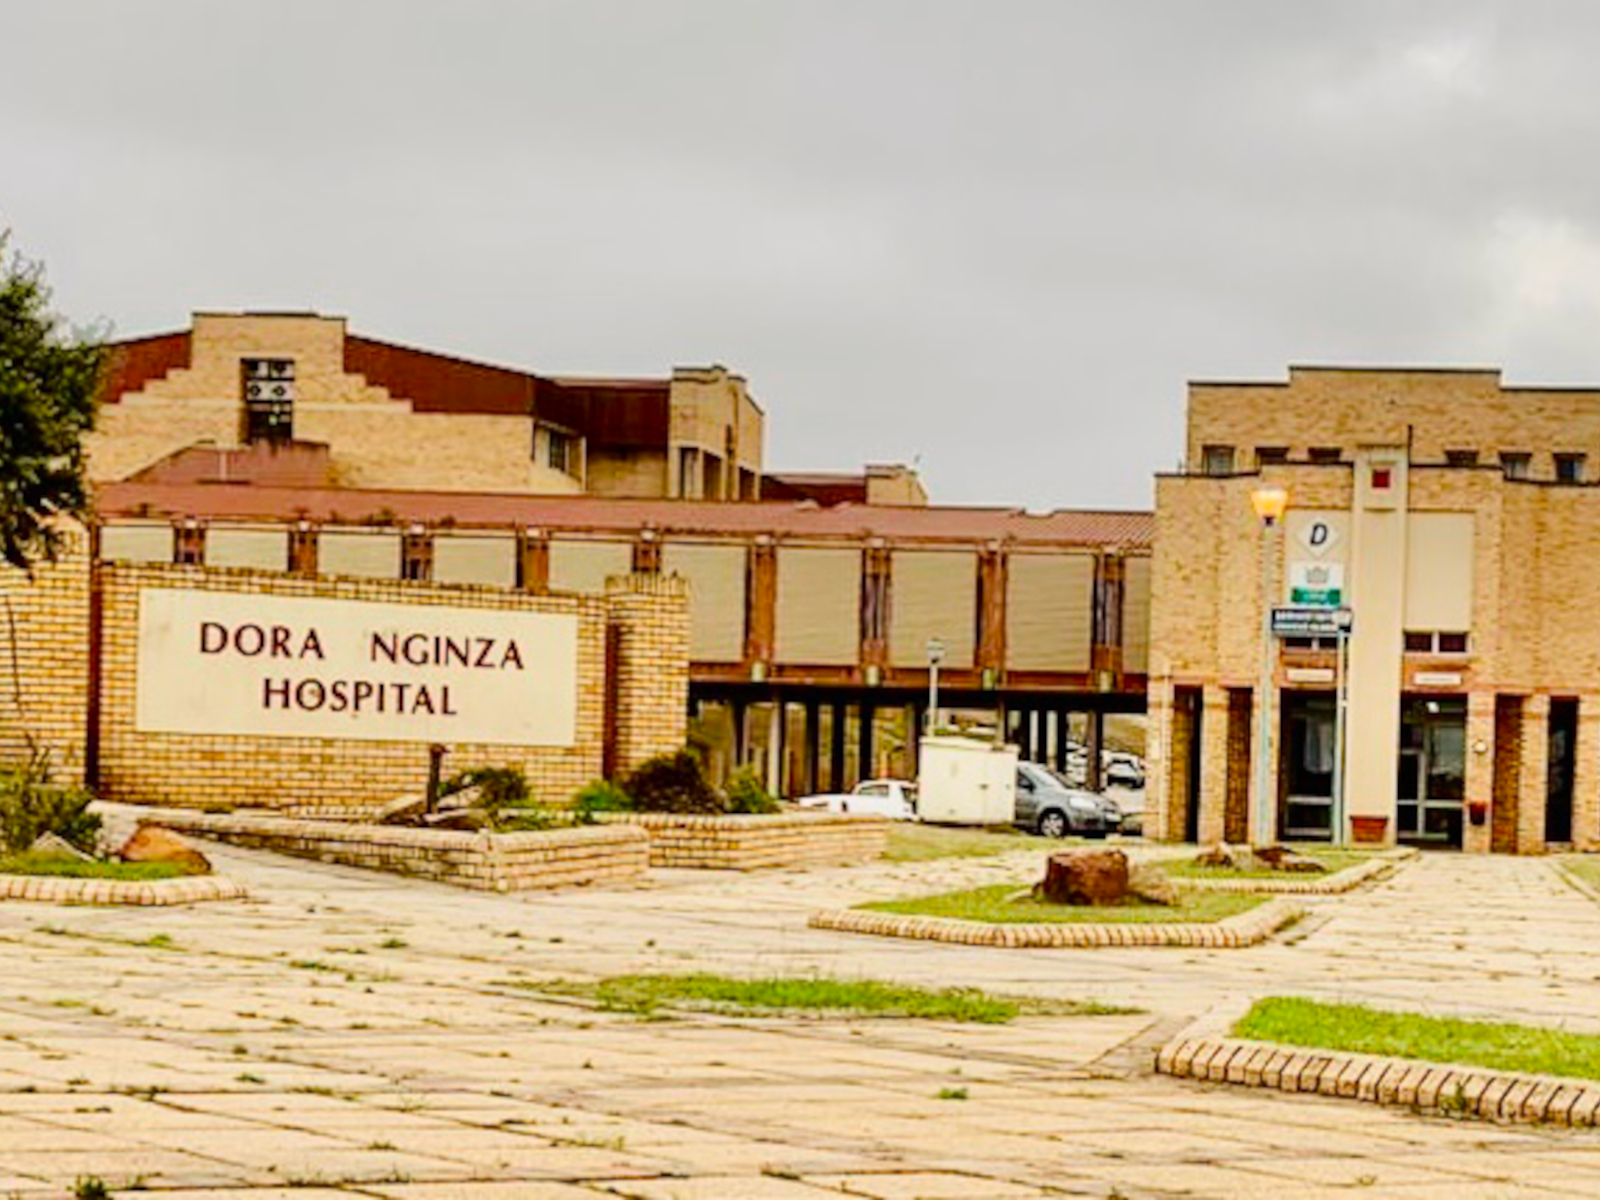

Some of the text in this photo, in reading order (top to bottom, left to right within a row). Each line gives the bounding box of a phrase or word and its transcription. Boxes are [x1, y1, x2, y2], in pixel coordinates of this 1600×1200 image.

[1310, 523, 1328, 545] D
[200, 622, 524, 670] DORA NGINZA
[263, 677, 457, 716] HOSPITAL
